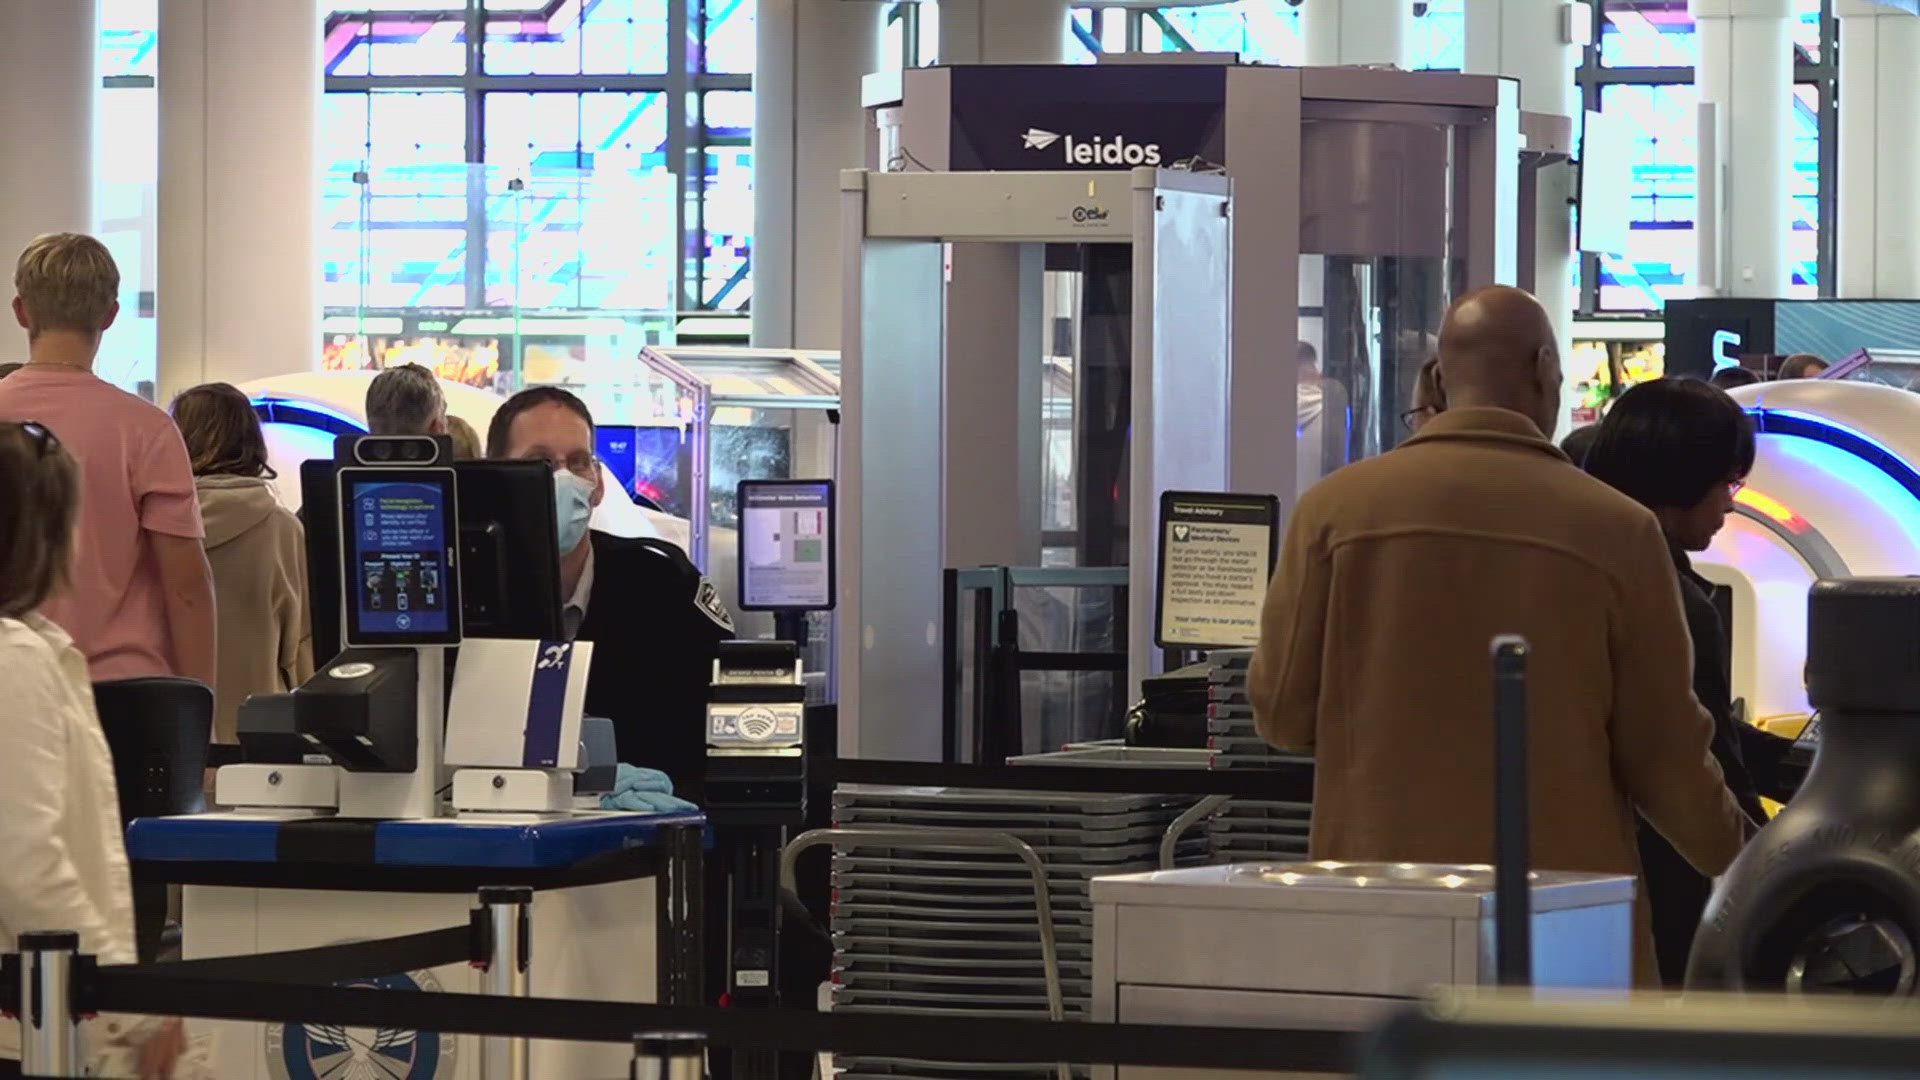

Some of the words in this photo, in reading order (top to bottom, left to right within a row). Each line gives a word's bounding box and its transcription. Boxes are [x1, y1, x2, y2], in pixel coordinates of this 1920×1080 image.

[1065, 135, 1161, 165] leidos
[1195, 508, 1224, 517] Advisory
[1194, 556, 1218, 565] through
